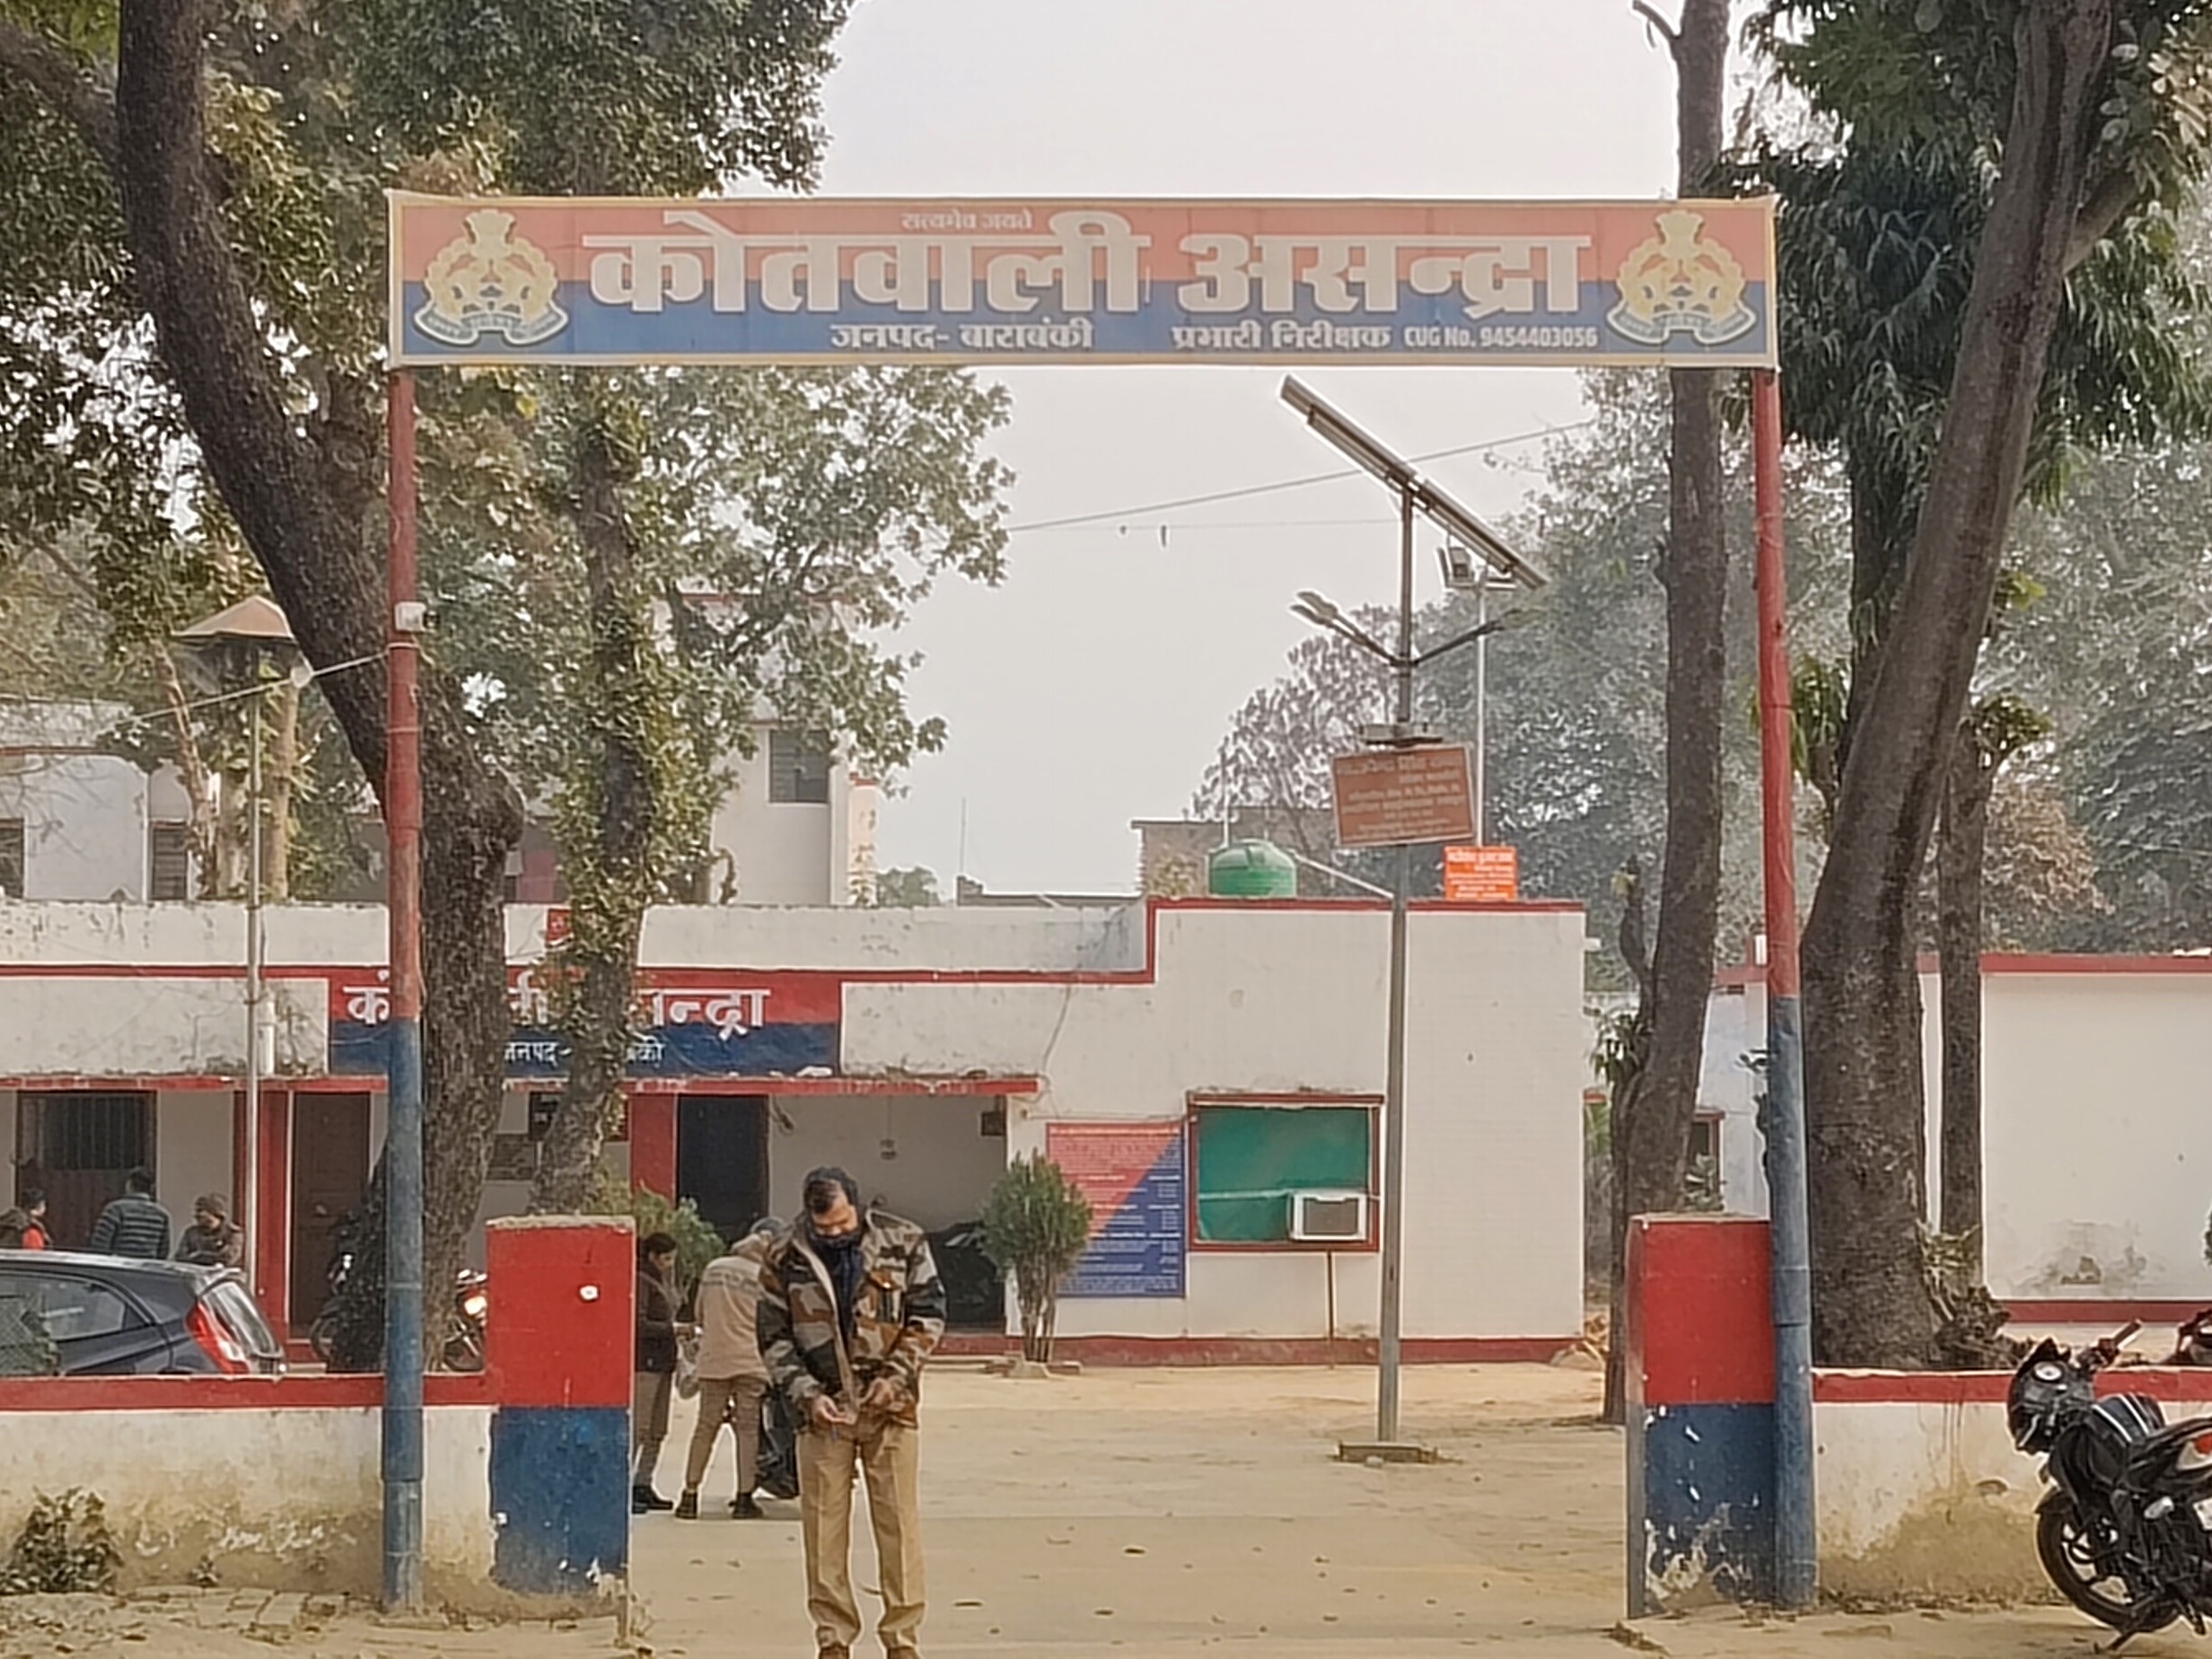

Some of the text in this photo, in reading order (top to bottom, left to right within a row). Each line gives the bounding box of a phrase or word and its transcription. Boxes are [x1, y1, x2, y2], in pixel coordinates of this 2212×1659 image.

[582, 210, 1592, 320] कोतवाली असन्द्रा
[1171, 320, 1262, 349] प्रभारी
[1271, 319, 1391, 349] निरीक्षक
[1404, 327, 1440, 347] CUG
[1444, 327, 1477, 347] No.
[1481, 327, 1598, 347] 9454403056
